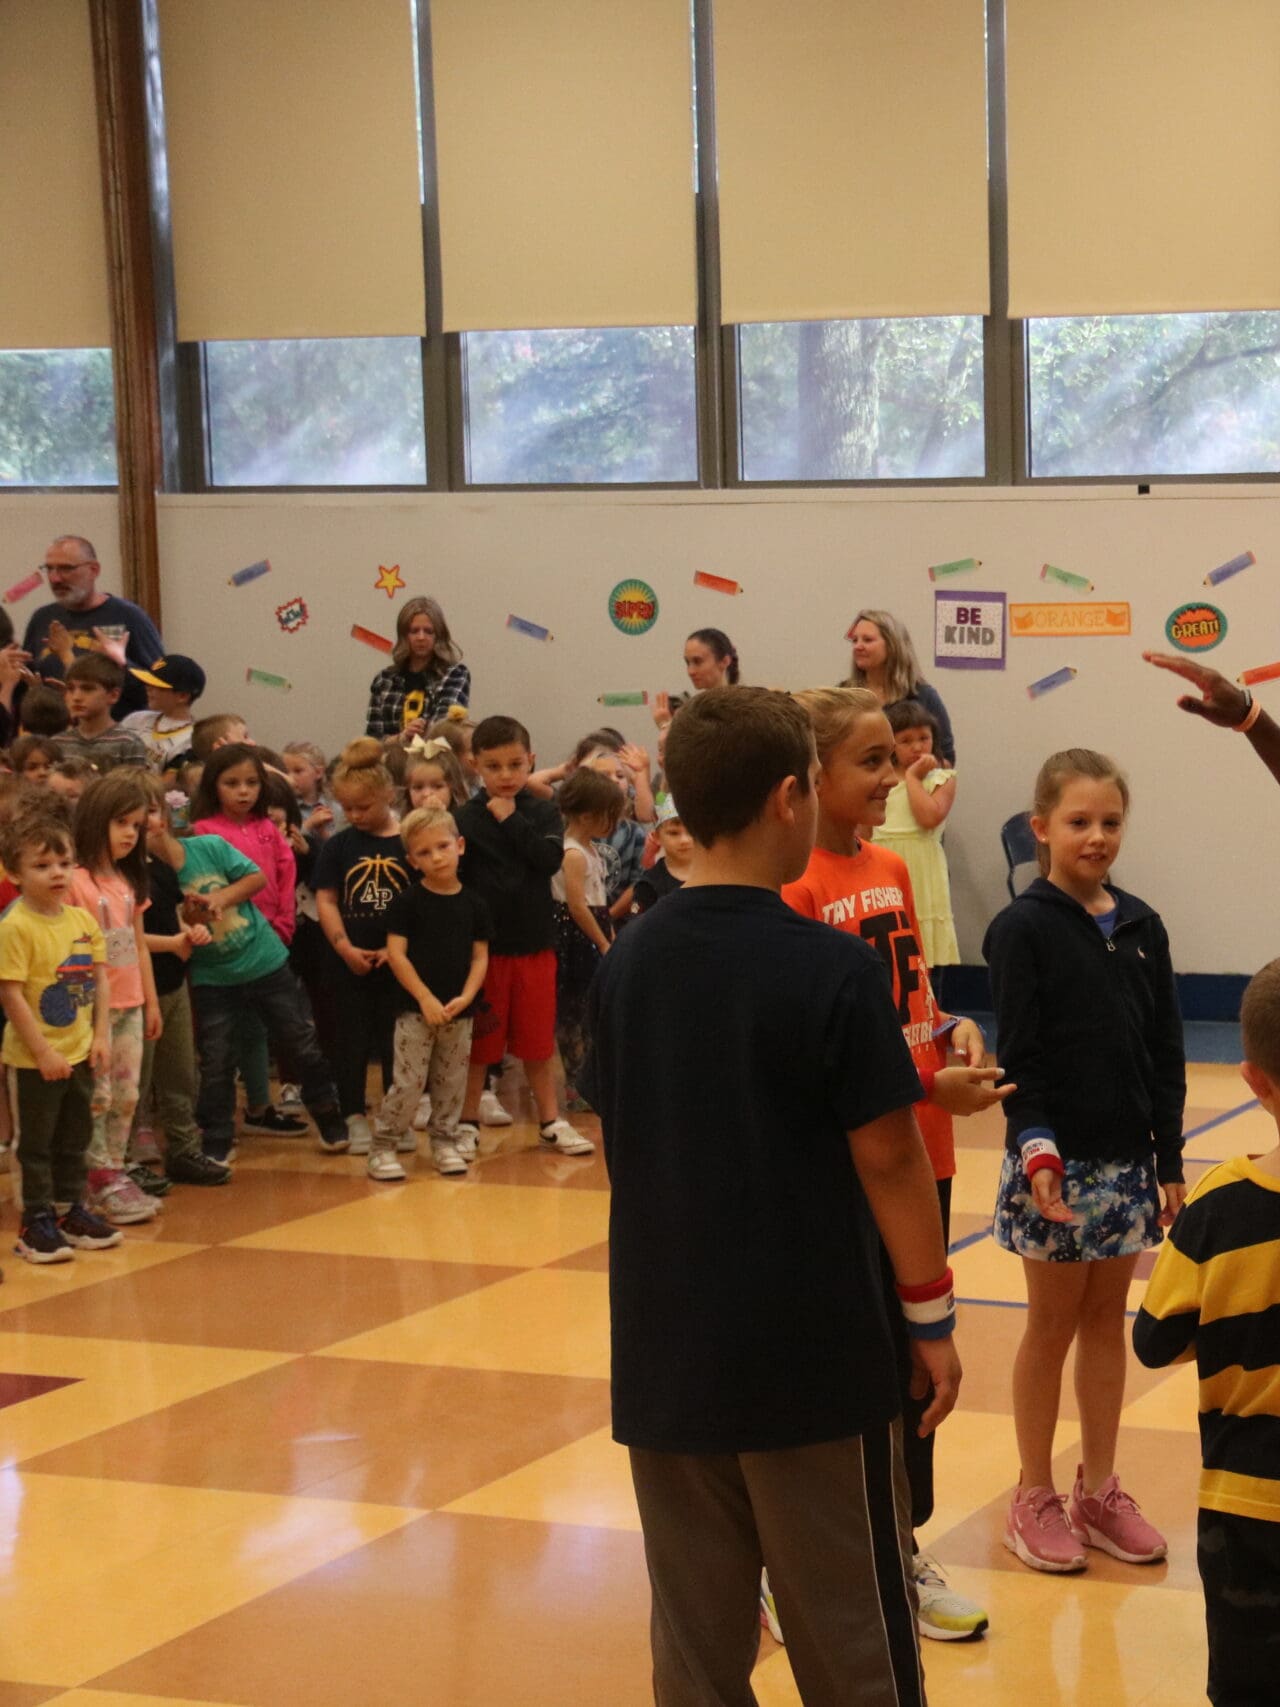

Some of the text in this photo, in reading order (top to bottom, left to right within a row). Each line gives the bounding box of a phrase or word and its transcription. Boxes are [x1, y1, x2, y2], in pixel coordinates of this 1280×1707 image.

[956, 607, 982, 625] BE
[1033, 611, 1105, 629] ORANGE
[944, 625, 995, 646] KIND
[822, 894, 856, 926] TAY
